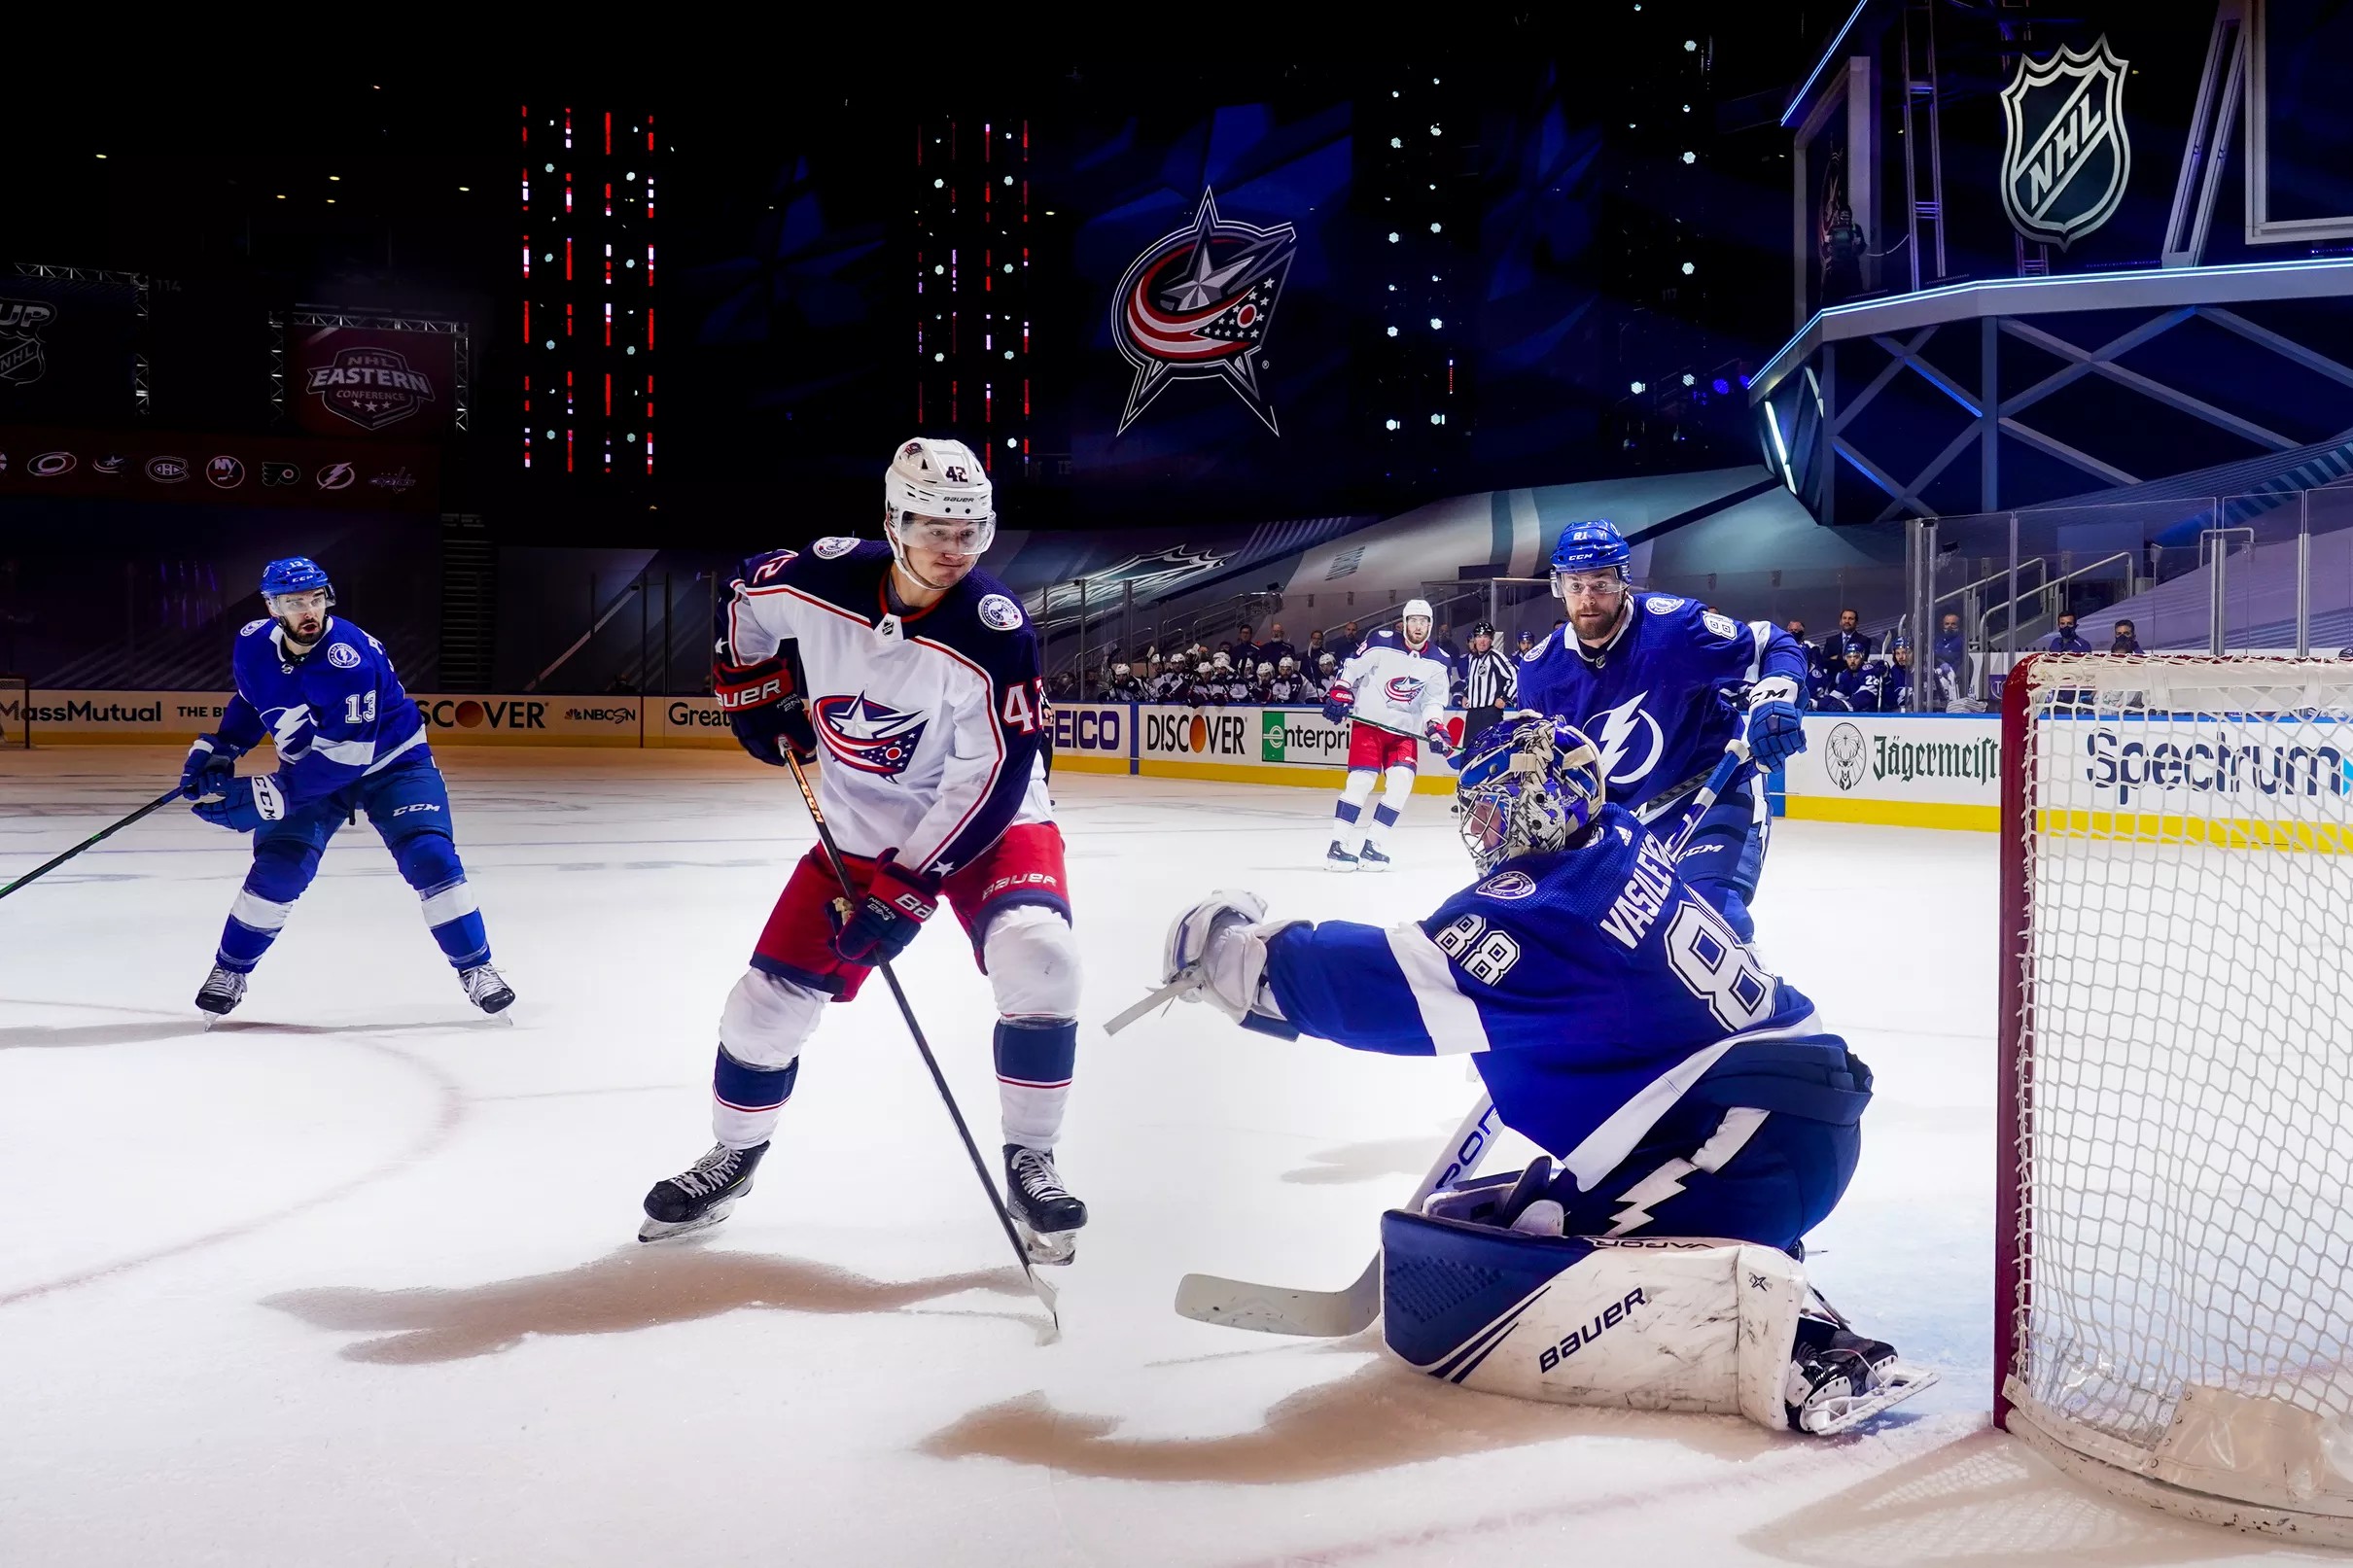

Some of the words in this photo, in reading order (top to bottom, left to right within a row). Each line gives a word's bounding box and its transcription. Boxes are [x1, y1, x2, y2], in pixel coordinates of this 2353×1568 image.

[2028, 93, 2101, 210] NHL
[0, 344, 35, 370] NHL
[346, 356, 396, 367] NHL
[311, 367, 431, 395] EASTERN
[335, 390, 406, 401] CONFERENCE
[945, 466, 968, 483] 42
[0, 700, 161, 721] MassMutual
[177, 706, 208, 717] THE
[212, 706, 228, 717] B
[345, 689, 377, 724] 13
[583, 708, 636, 725] NBCSN
[668, 702, 731, 727] Great
[1146, 713, 1246, 755] DISCOVER
[1873, 735, 2002, 785] Jägermeist
[2087, 726, 2341, 805] Spectrum
[393, 803, 440, 818] CCM
[1433, 913, 1520, 987] 88
